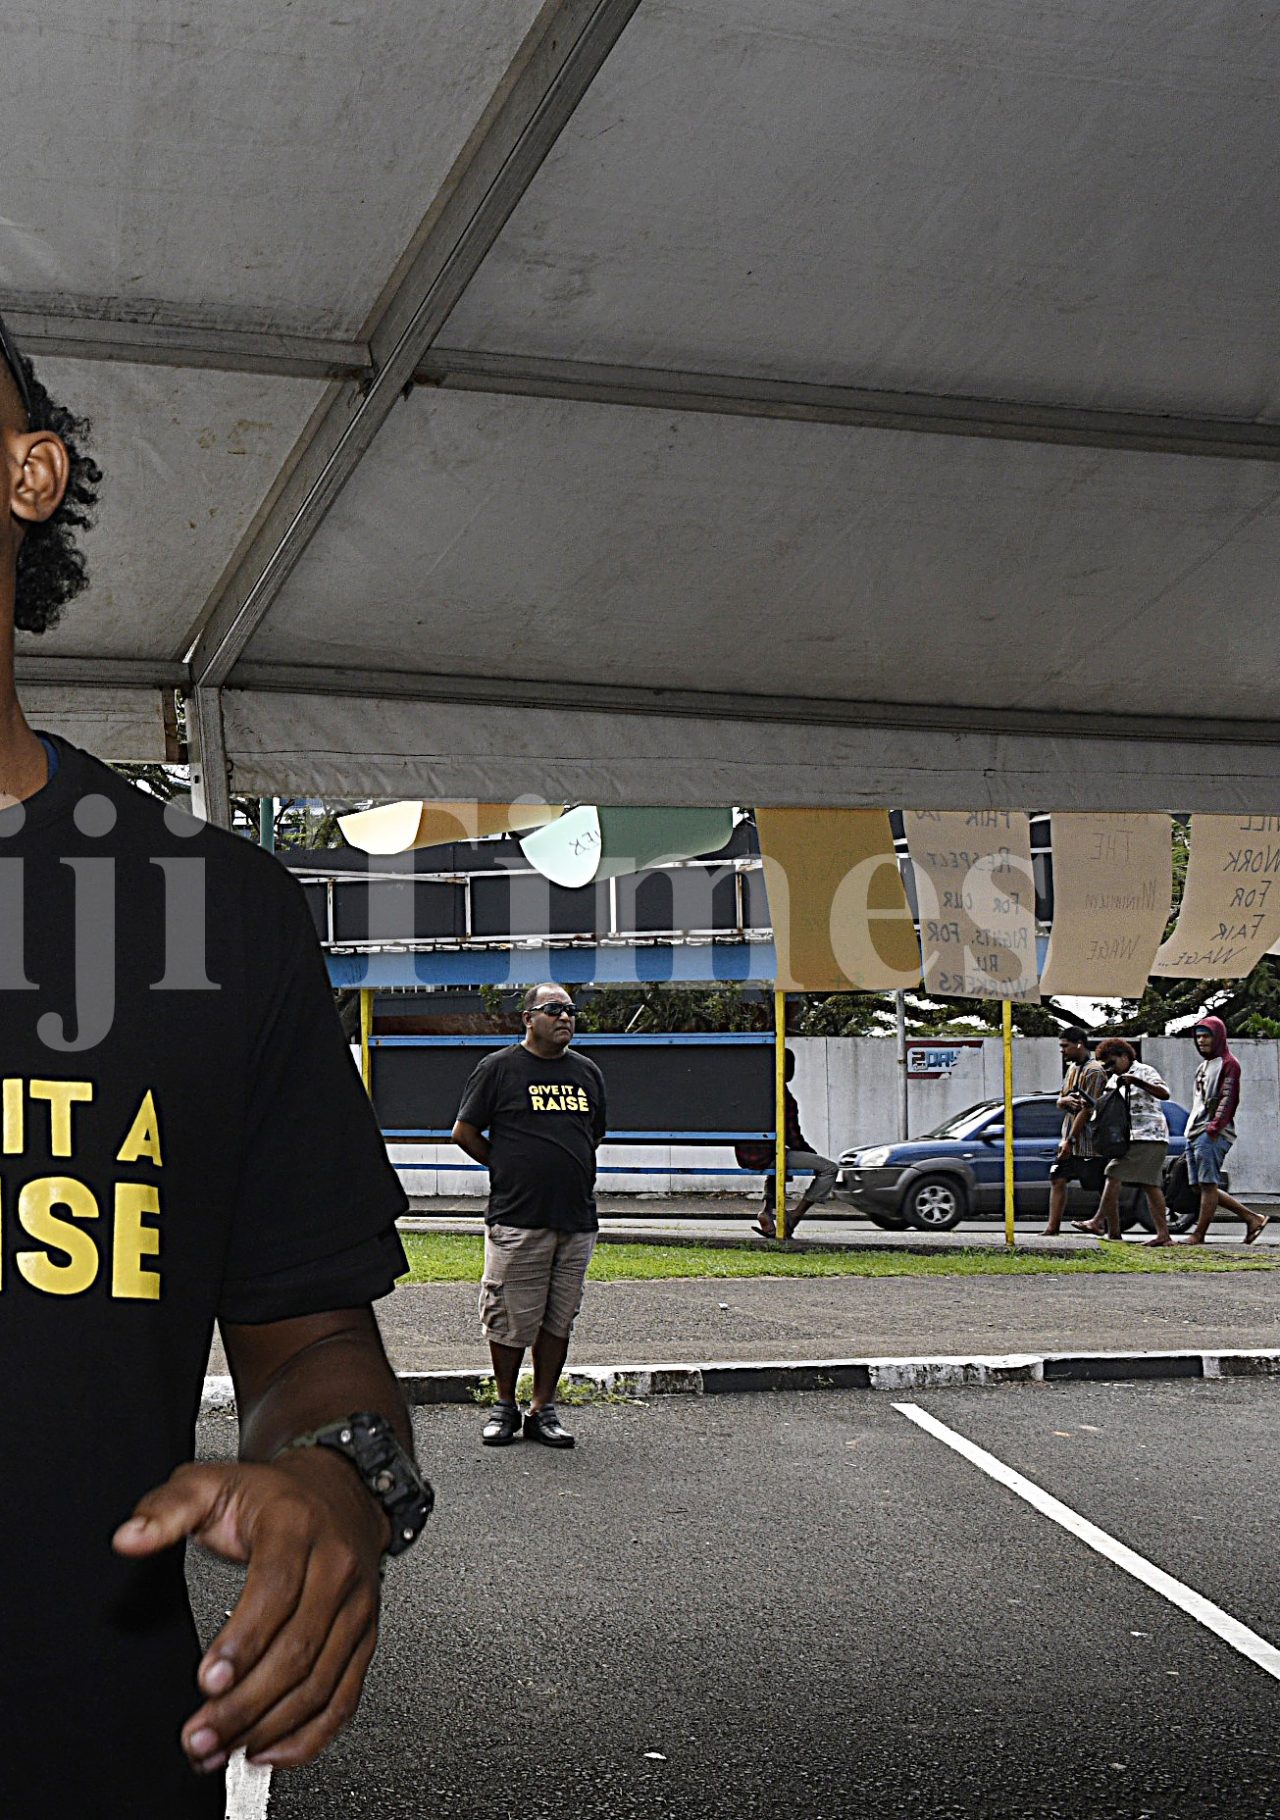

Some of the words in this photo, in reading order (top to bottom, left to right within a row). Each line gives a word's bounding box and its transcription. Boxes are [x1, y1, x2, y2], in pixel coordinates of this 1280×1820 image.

[528, 1084, 560, 1096] GIVE
[560, 1084, 574, 1096] IT
[577, 1087, 587, 1097] A
[531, 1095, 590, 1112] RAISE
[2, 1078, 94, 1157] IT
[116, 1089, 163, 1167] A
